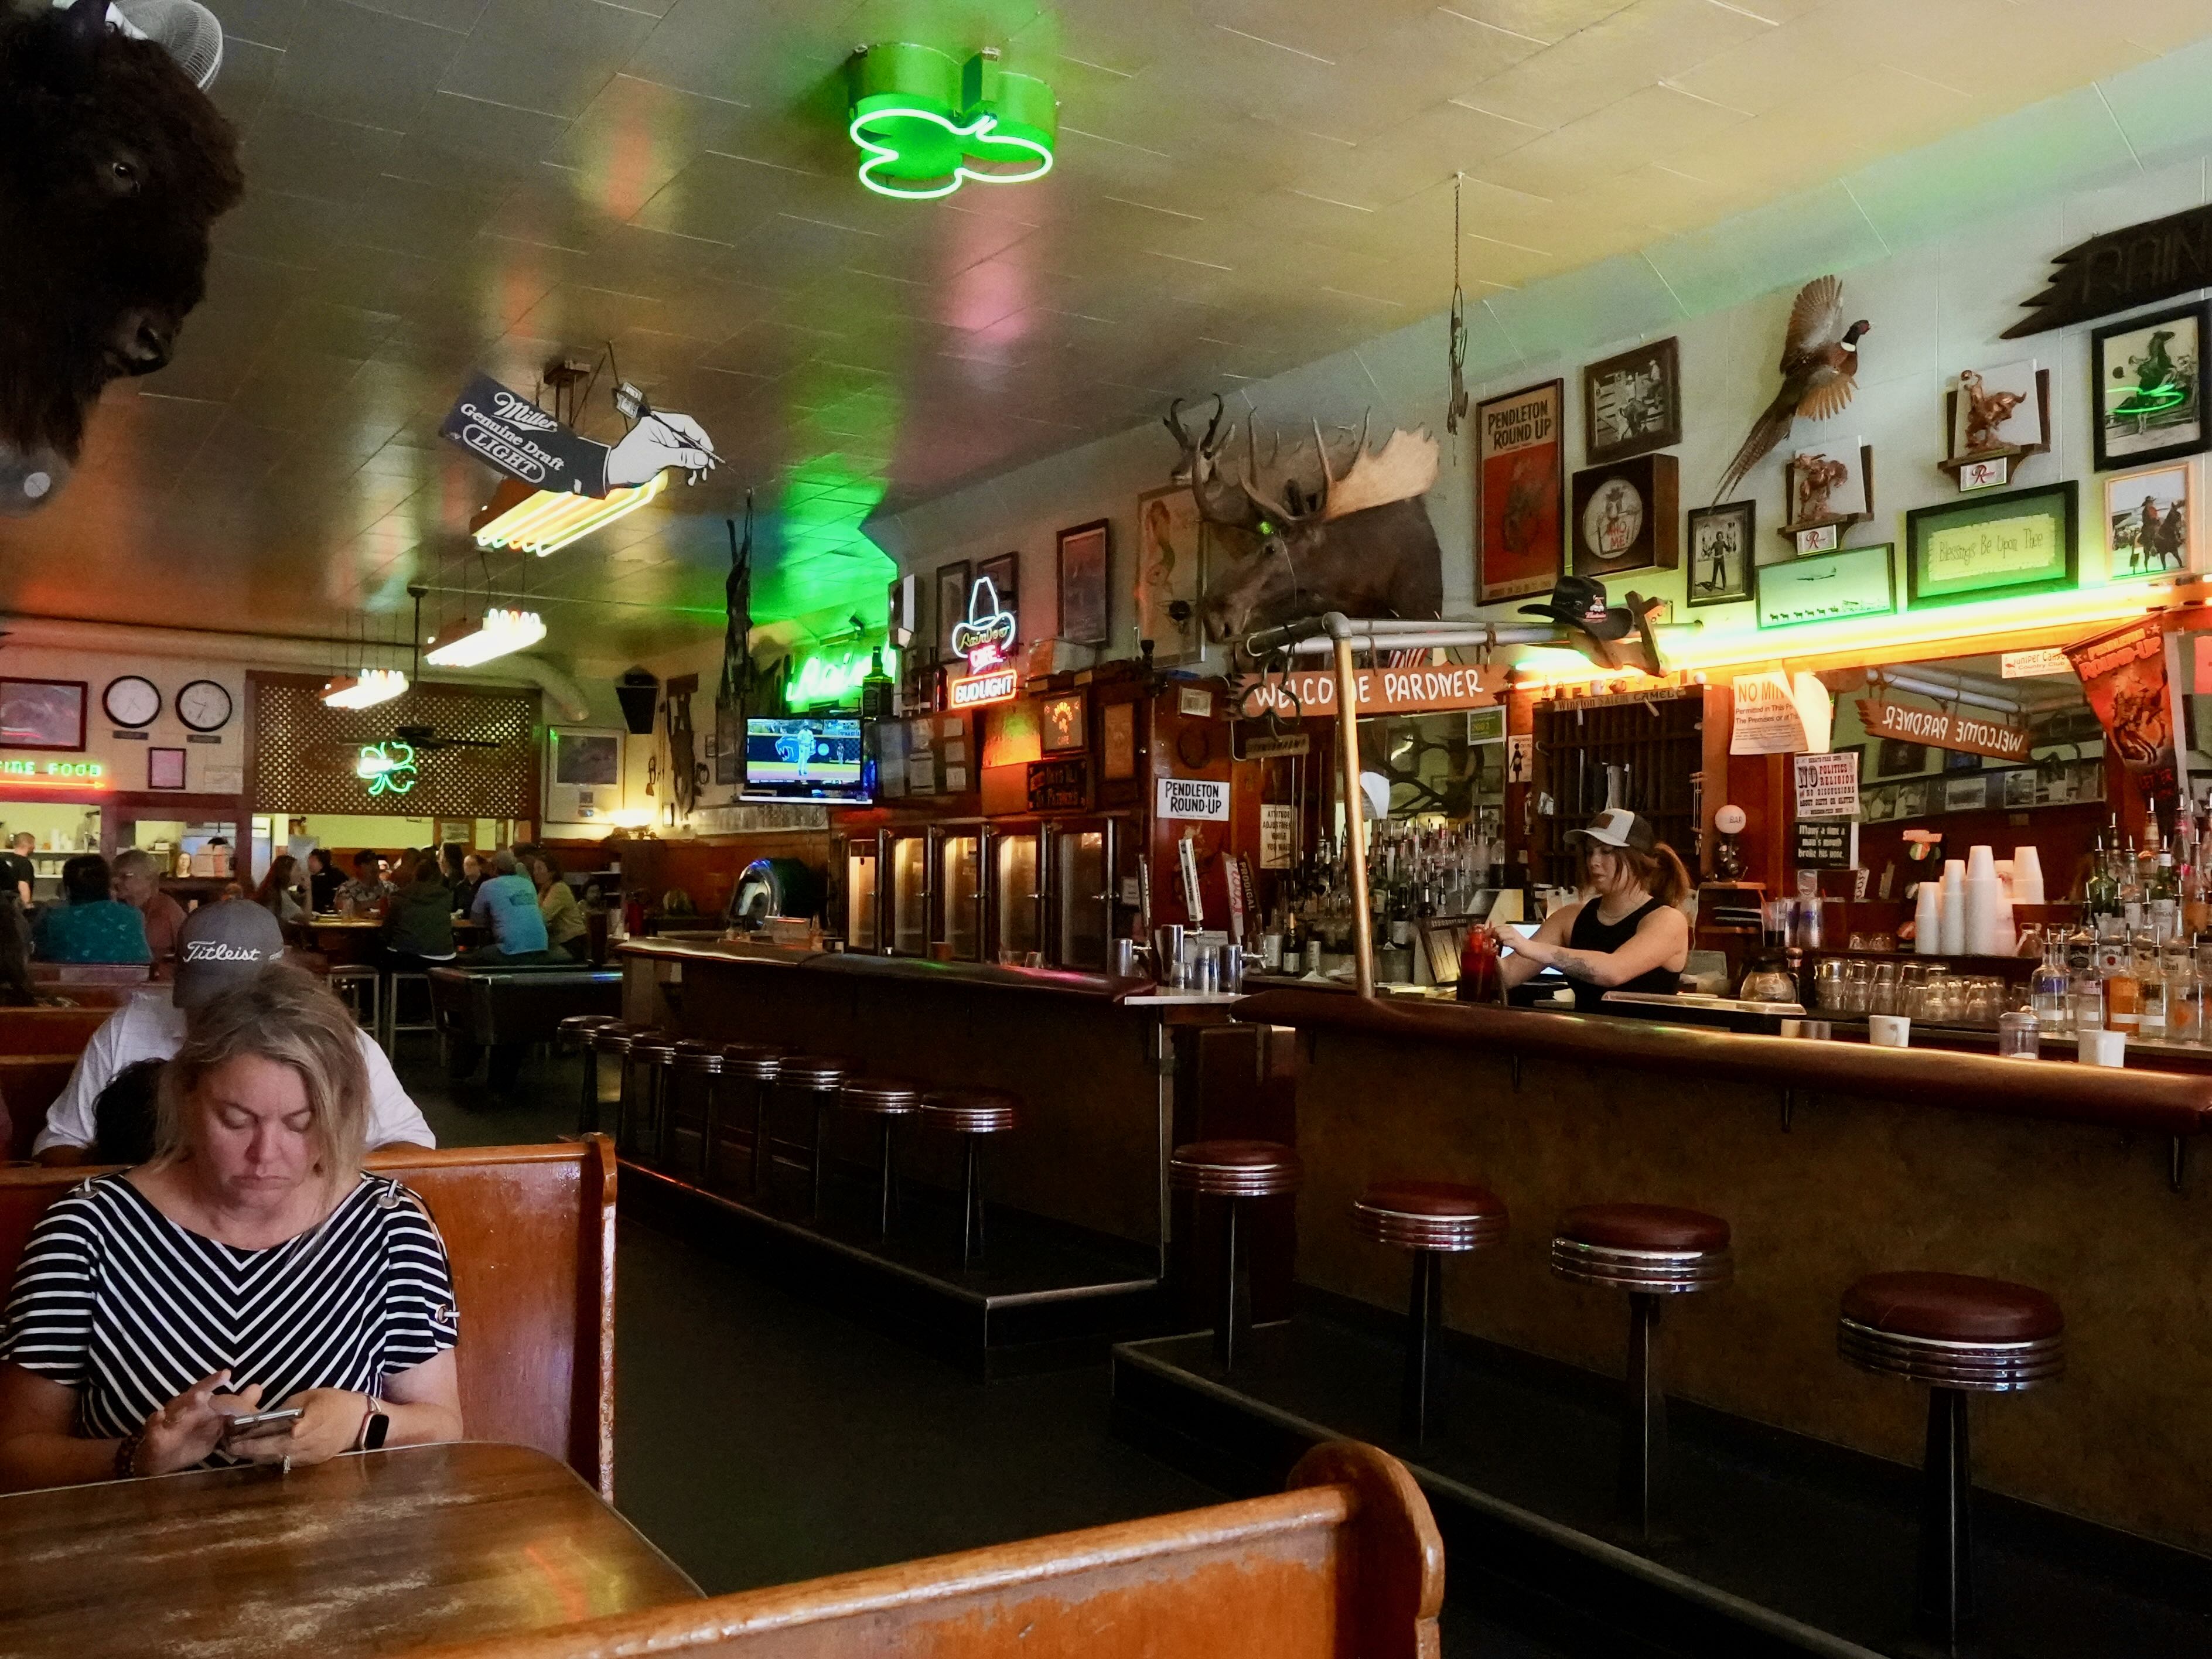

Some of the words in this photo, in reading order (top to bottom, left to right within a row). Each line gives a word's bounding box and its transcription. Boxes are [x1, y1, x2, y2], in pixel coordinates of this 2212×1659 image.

[494, 391, 558, 431] Miller
[1488, 399, 1548, 435] PENDLETON
[460, 403, 524, 446] Genuine
[521, 441, 565, 471] Draft
[1494, 424, 1532, 451] ROUND
[1535, 418, 1552, 439] UP
[471, 432, 538, 475] LIGHT
[1939, 541, 1978, 566] Blessings
[1980, 534, 1992, 555] Be
[1996, 535, 2018, 559] Upon
[2023, 527, 2043, 549] Thee
[2013, 653, 2040, 665] Juniper
[955, 682, 979, 704] BUD
[979, 674, 1013, 698] LIGHT
[1254, 675, 1371, 709] WELCOE
[1384, 668, 1484, 704] PARDNER
[1738, 682, 1757, 702] NO
[1735, 706, 1763, 715] Permitted
[47, 762, 102, 777] FOOD
[1797, 765, 1818, 788] NO
[1819, 763, 1848, 774] POLITICS
[1820, 774, 1855, 786] RELIGION
[1165, 781, 1219, 798] PENDLETON
[1817, 786, 1855, 796] DISCUSSIONS
[1267, 810, 1291, 818] ATTITUDE
[1238, 861, 1256, 912] PRODIGAL
[183, 940, 261, 962] Titleist
